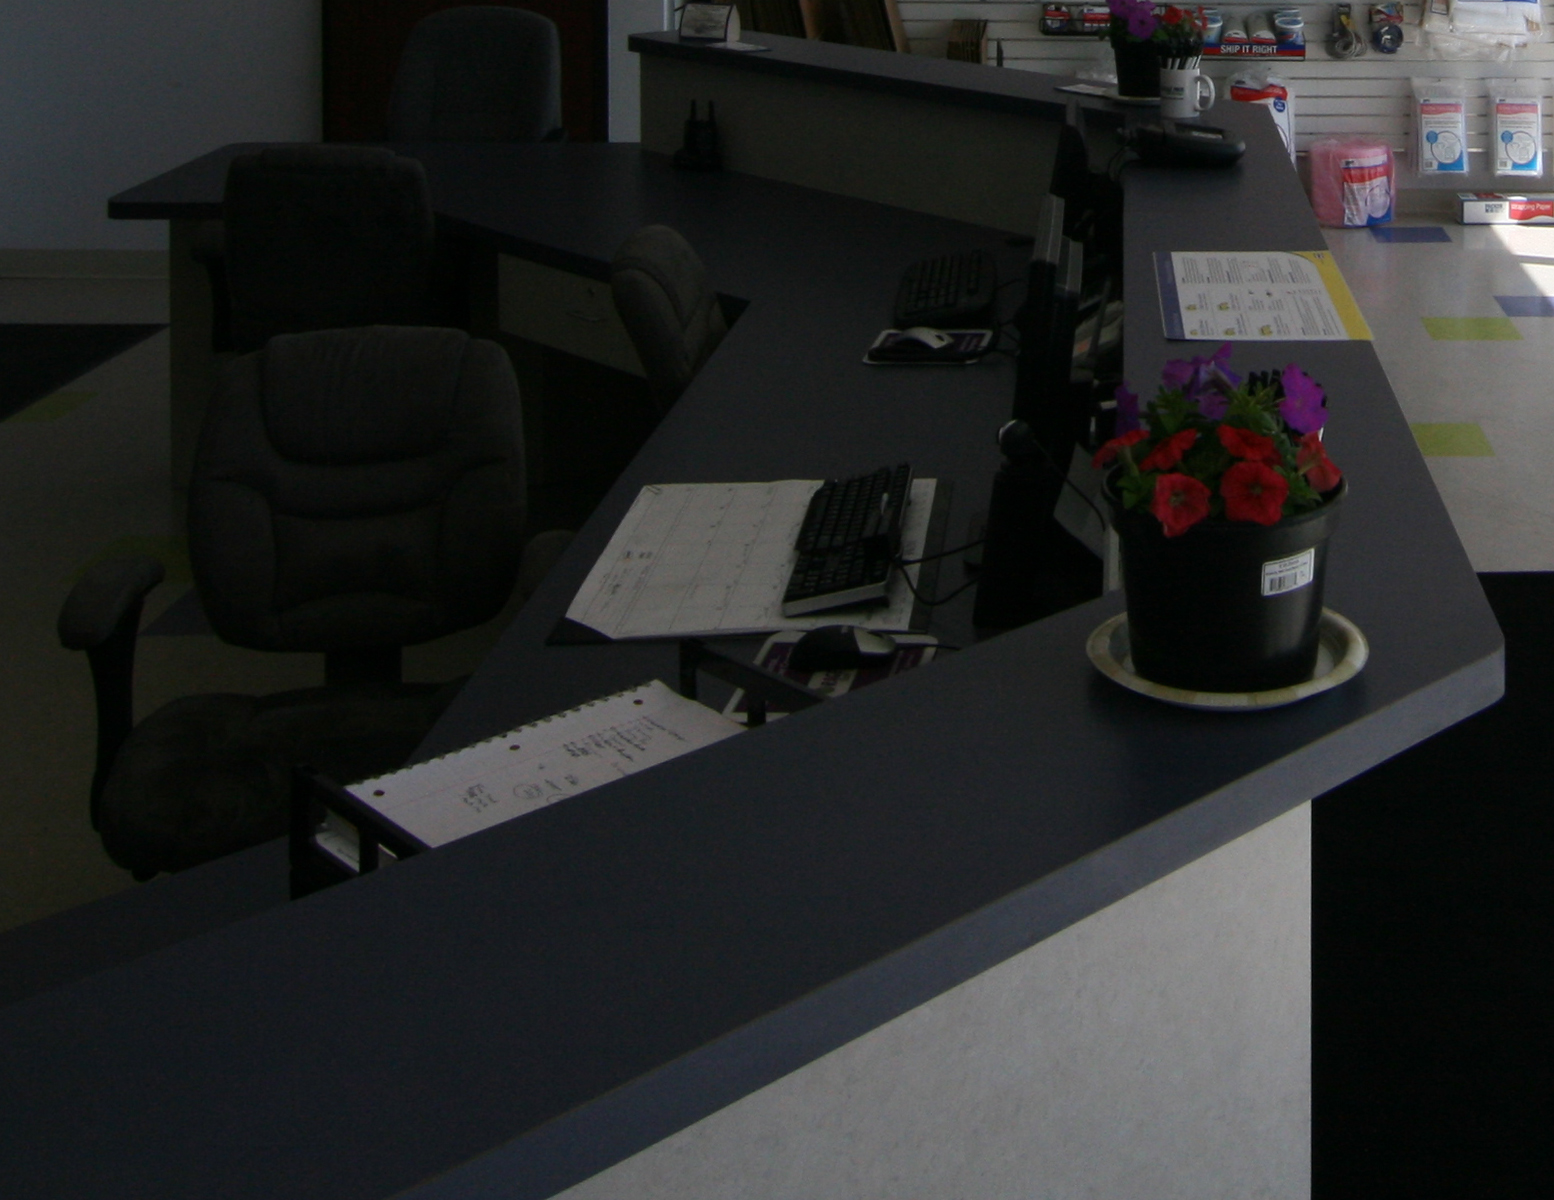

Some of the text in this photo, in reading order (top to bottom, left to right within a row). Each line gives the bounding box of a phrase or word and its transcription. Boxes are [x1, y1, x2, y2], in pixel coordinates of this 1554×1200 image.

[1220, 44, 1278, 54] SHIP IT RIGHT
